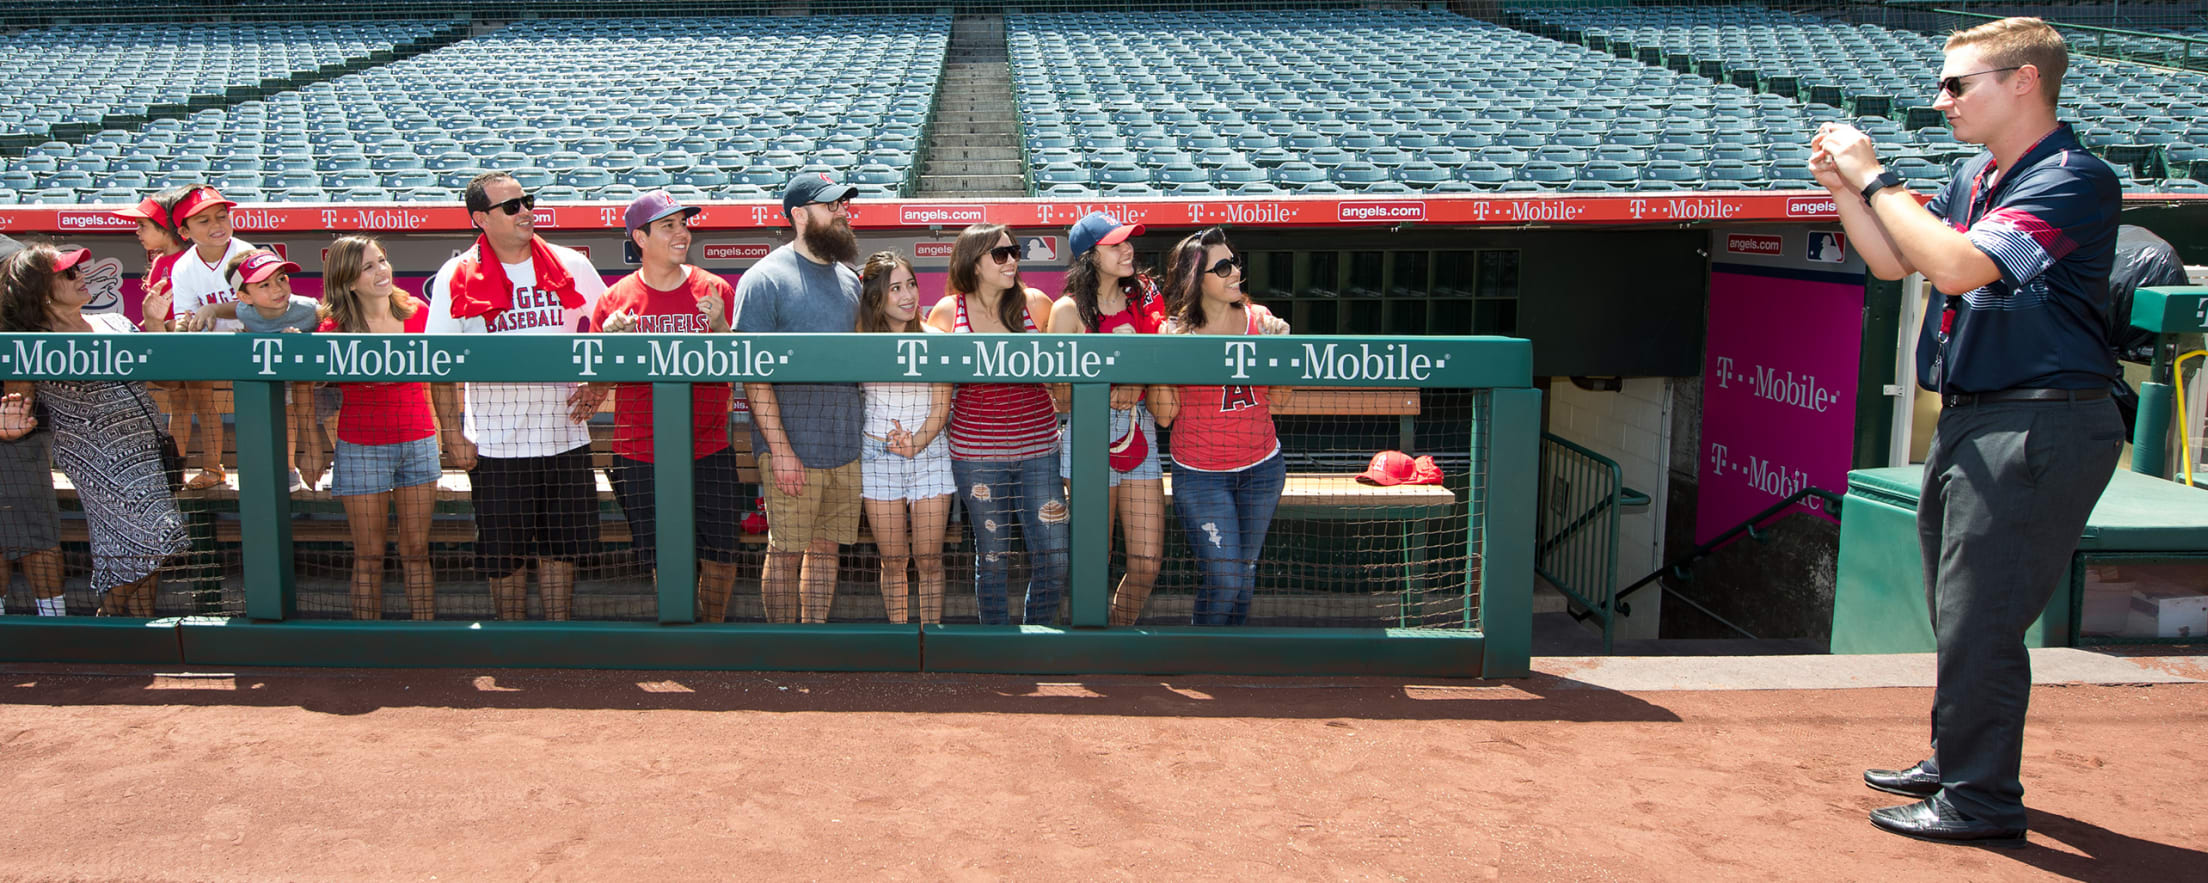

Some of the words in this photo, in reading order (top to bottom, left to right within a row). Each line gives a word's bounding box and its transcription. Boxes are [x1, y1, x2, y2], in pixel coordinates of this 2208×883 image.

[903, 208, 982, 222] angels.com
[1342, 204, 1421, 219] angels.com
[230, 210, 286, 229] obile
[1729, 237, 1780, 251] angels.com
[706, 247, 768, 258] angels.com
[1220, 385, 1258, 412] A
